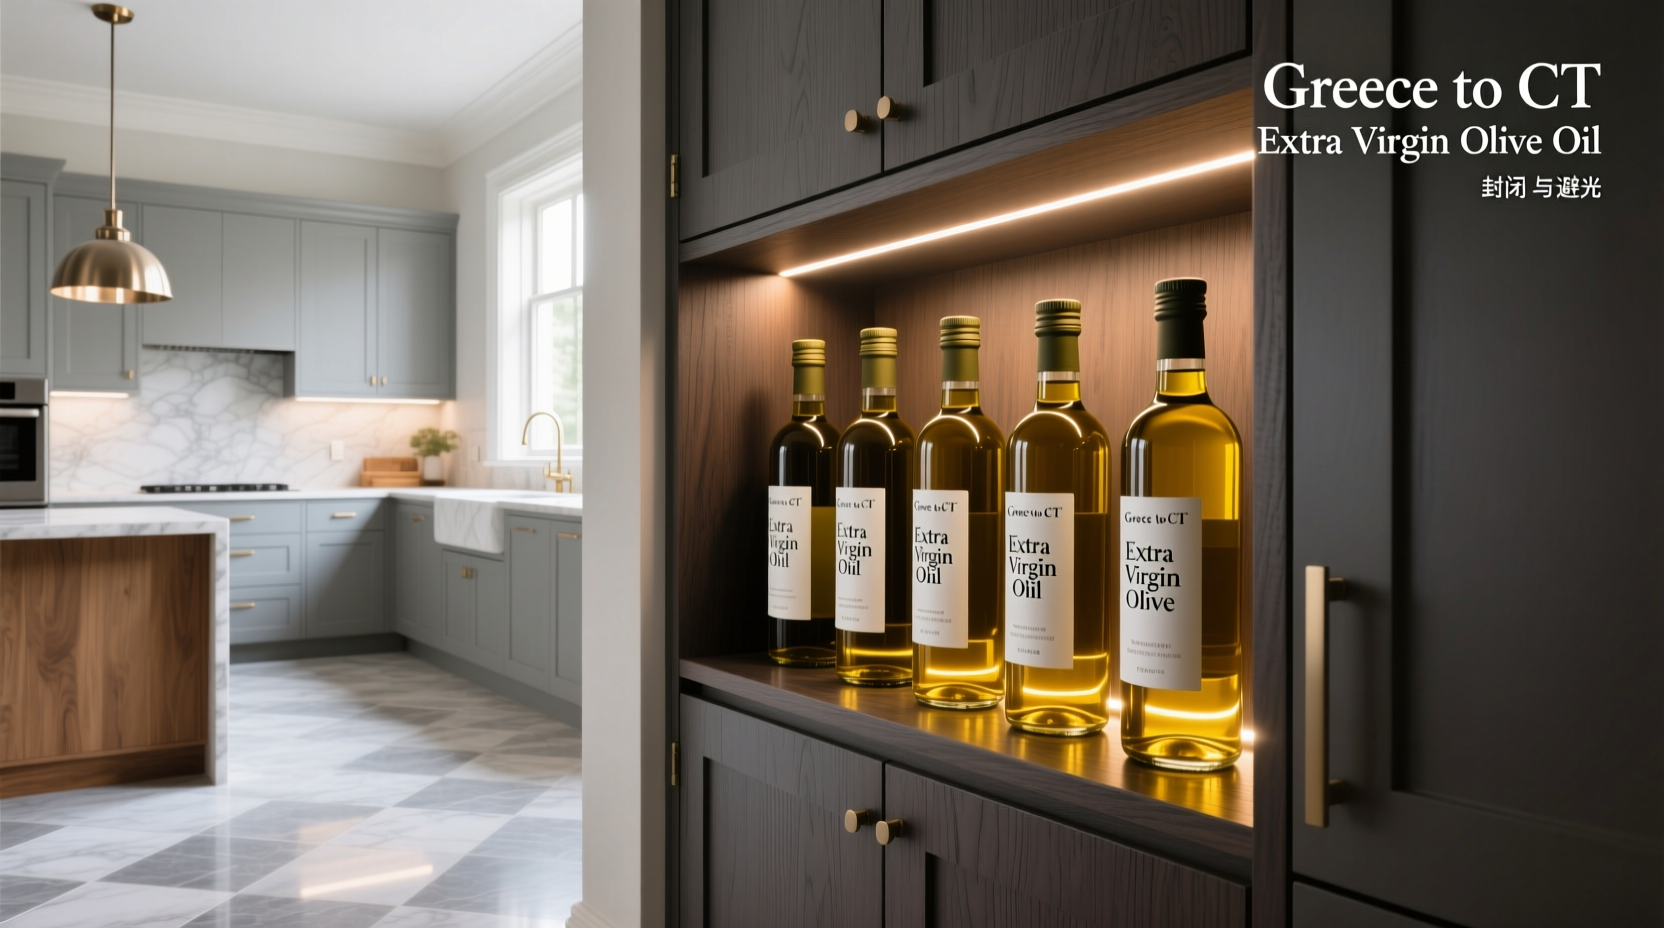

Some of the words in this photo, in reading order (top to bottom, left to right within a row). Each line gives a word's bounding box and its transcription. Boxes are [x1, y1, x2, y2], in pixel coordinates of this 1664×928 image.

[1044, 507, 1062, 518] CT
[1167, 512, 1189, 525] CT
[837, 522, 867, 539] Extra
[914, 526, 949, 545] Extra
[1009, 535, 1050, 554] Extra
[1125, 541, 1174, 563] Extra
[1009, 556, 1057, 580] Virgin
[1125, 564, 1181, 592] Virgin
[1126, 589, 1175, 612] Olive
